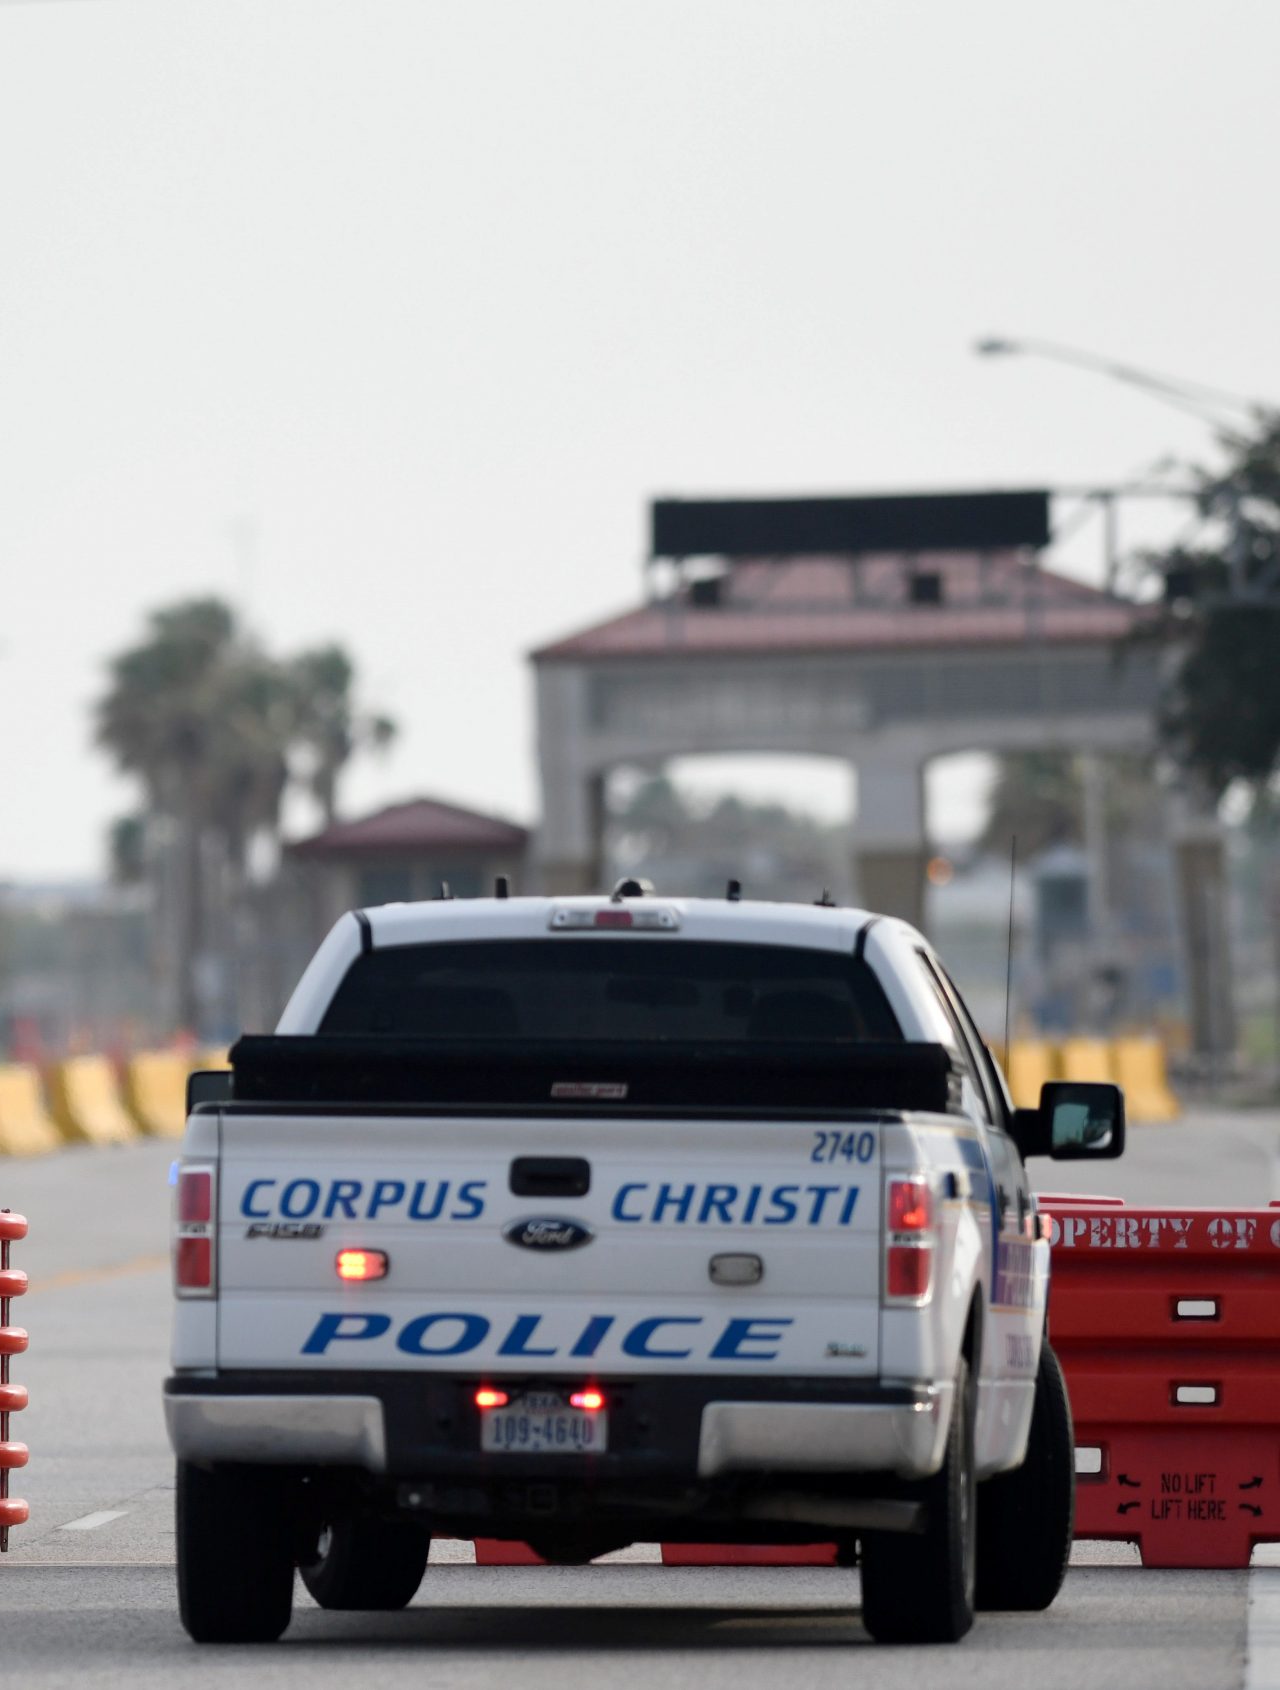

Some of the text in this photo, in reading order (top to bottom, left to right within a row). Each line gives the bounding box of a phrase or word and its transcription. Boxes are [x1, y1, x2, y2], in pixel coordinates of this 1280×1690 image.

[811, 1131, 875, 1163] 2740
[240, 1178, 860, 1226] CORPUS CHRISTI
[522, 1221, 574, 1245] Ford
[1207, 1217, 1258, 1248] OF
[300, 1312, 795, 1361] POLICE
[1161, 1474, 1216, 1494] NO LIFT
[1151, 1499, 1226, 1520] LIFT HERE
